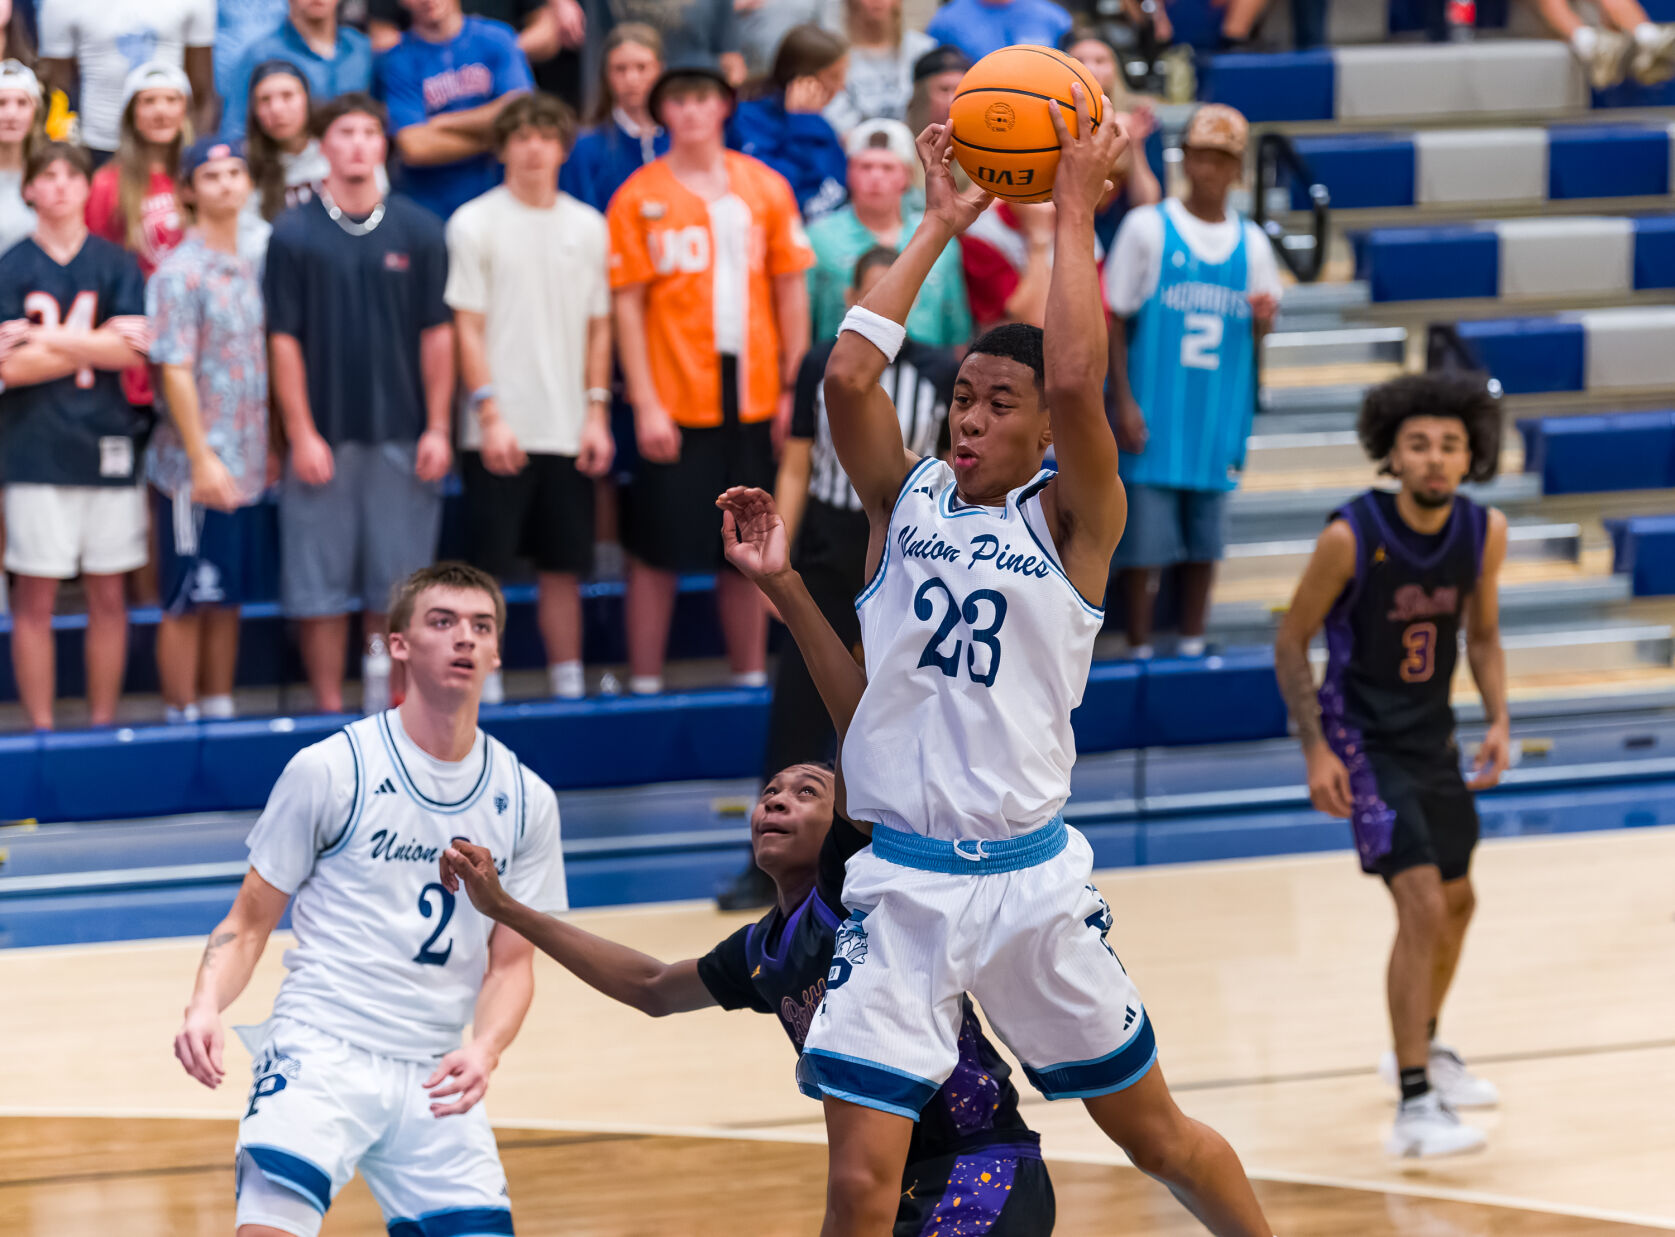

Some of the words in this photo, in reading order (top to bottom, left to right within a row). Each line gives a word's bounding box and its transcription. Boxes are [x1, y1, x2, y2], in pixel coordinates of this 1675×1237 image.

[977, 166, 1034, 185] EVO
[1180, 313, 1224, 370] 2
[898, 525, 961, 563] Union
[968, 534, 1050, 578] Pines
[914, 577, 1007, 687] 23
[1399, 621, 1437, 683] 3
[370, 829, 438, 864] Union
[412, 882, 456, 967] 2
